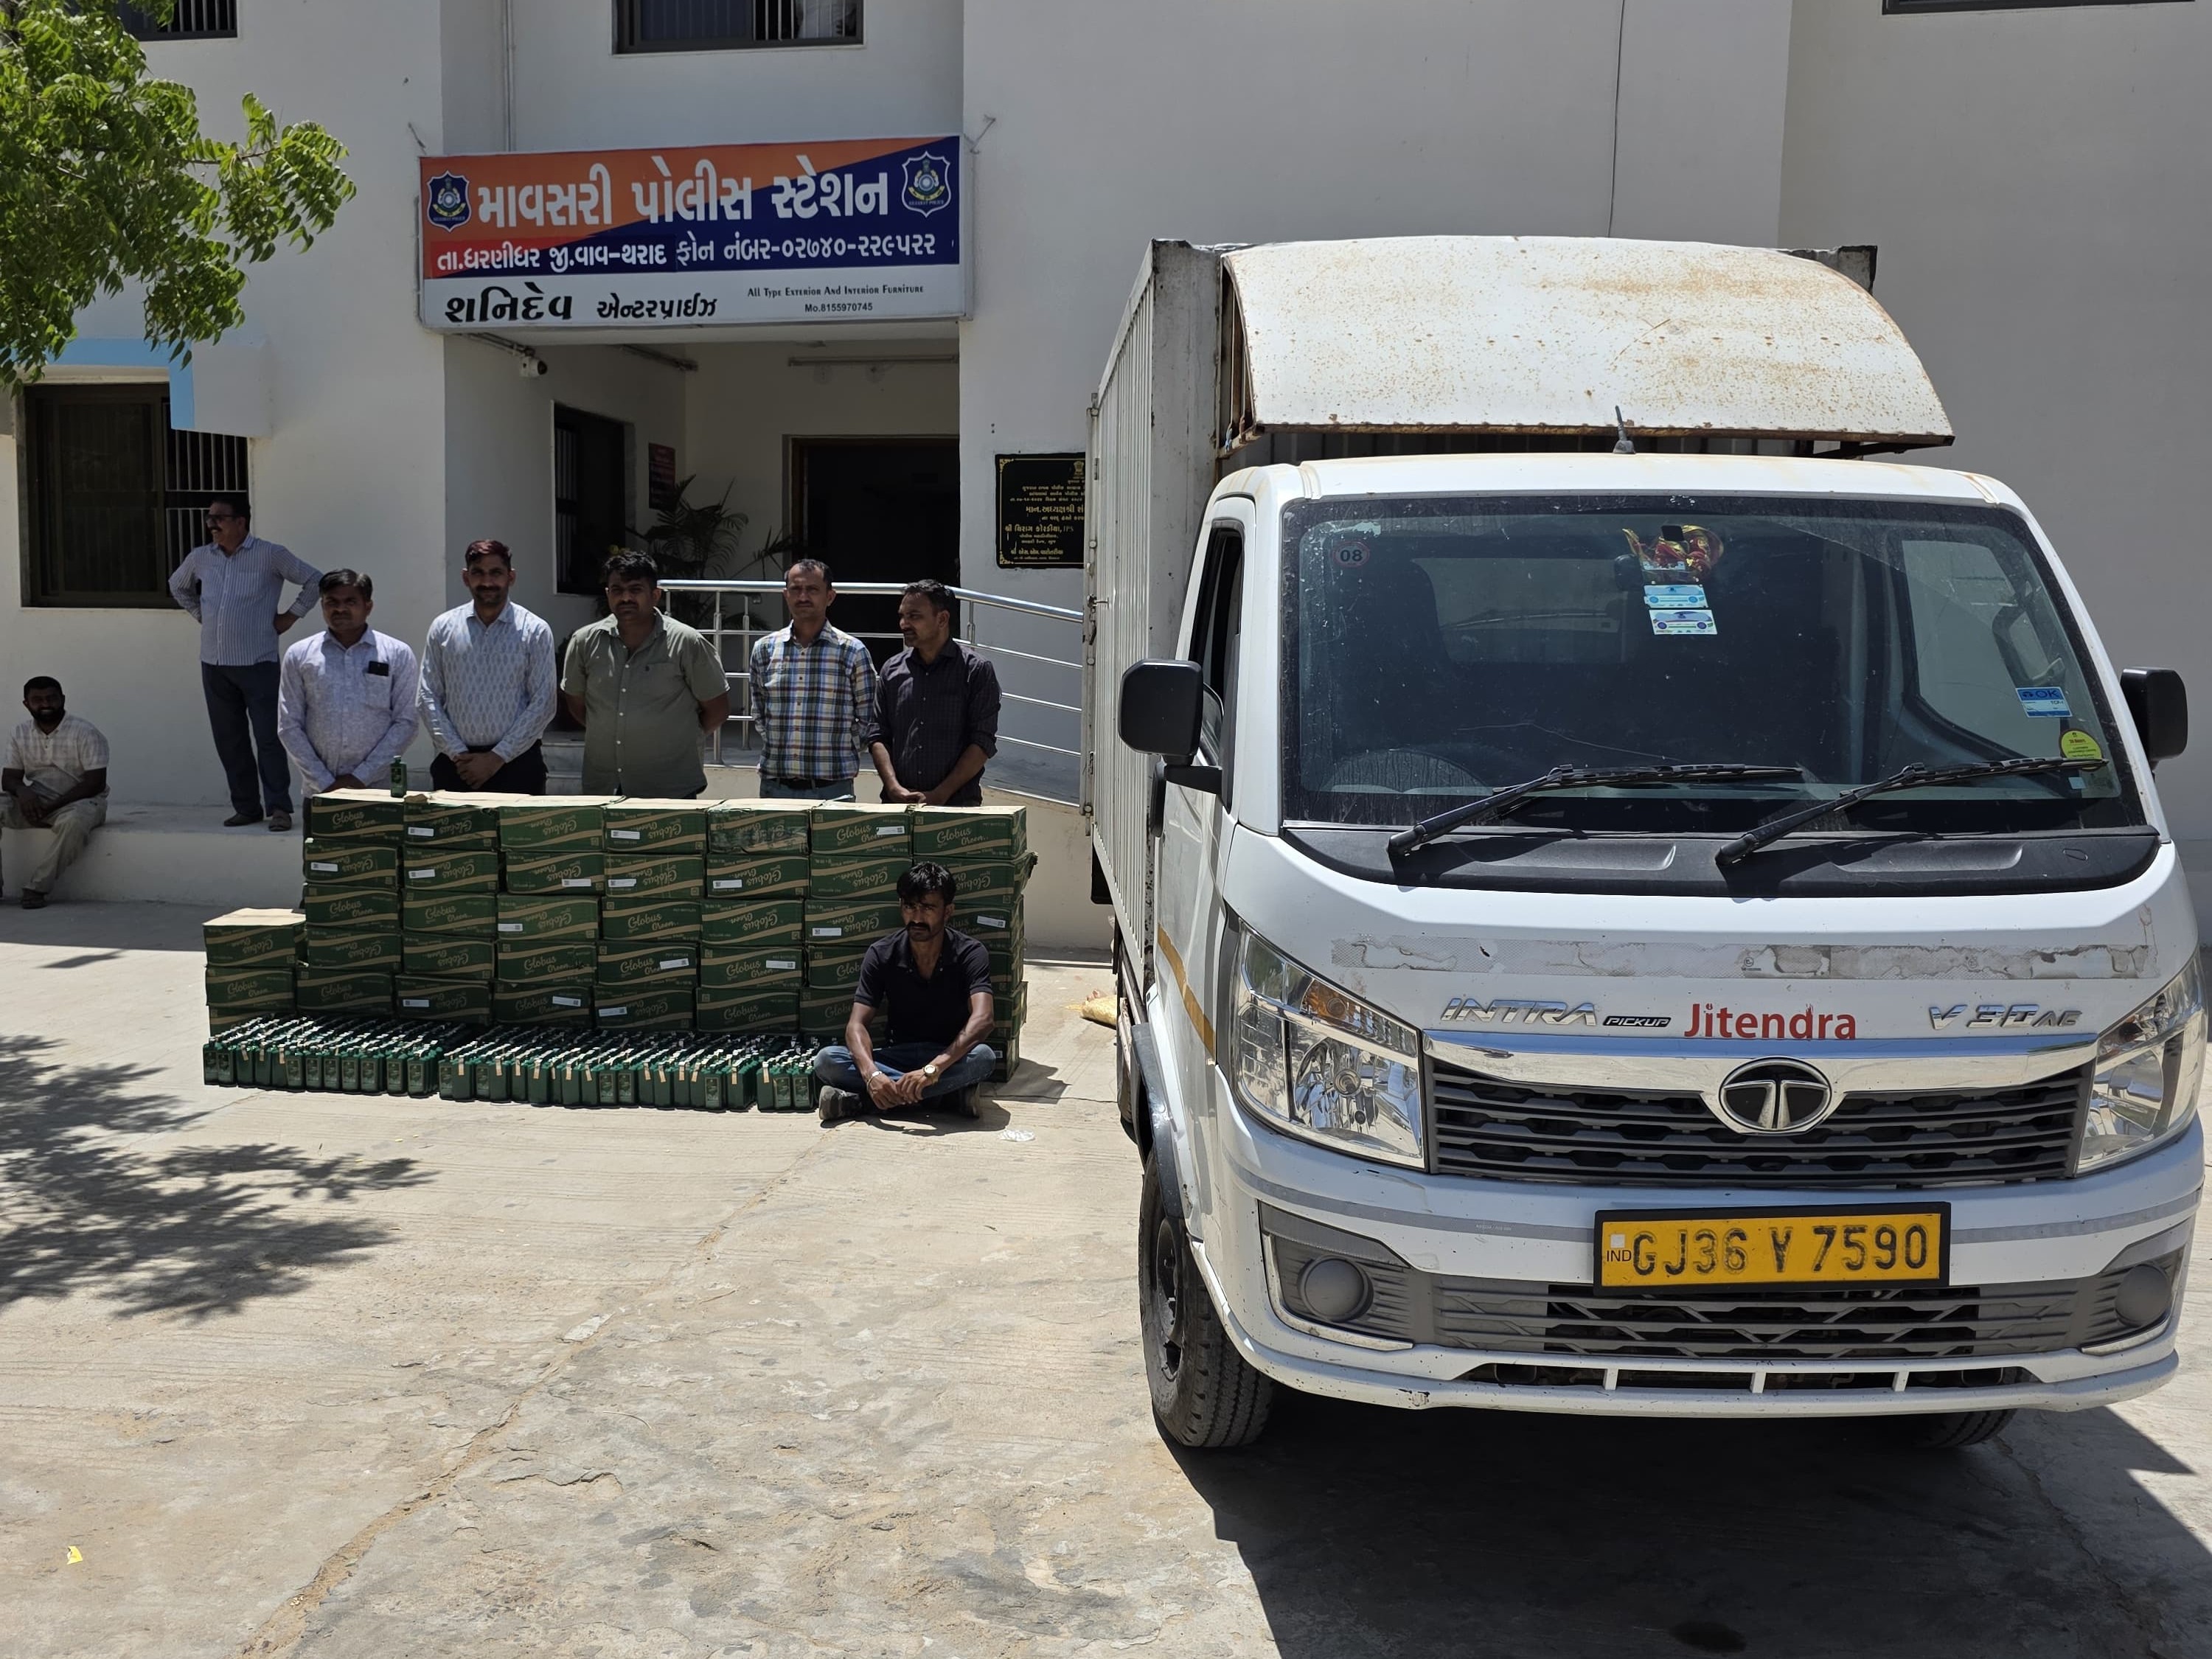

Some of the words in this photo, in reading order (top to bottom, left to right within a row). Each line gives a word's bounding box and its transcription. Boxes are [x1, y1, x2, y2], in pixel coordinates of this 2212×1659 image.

[478, 162, 613, 228] માવસરી
[631, 156, 752, 224] પોલીસ
[771, 154, 888, 219] સ્ટેશન
[437, 241, 540, 271] તા.ધરણીધર
[675, 230, 714, 266] ફોન
[445, 282, 573, 323] શનિદેવ
[804, 302, 873, 313] Mo.8155970745
[1340, 550, 1363, 562] 08
[936, 827, 973, 844] Globus
[746, 869, 782, 886] Globus
[956, 874, 991, 891] Globus
[627, 912, 663, 929] Globus
[743, 912, 778, 931] Globus
[619, 957, 654, 974] Globus
[726, 960, 761, 977] Globus
[836, 961, 861, 978] Glob
[1440, 998, 1597, 1026] INTRA
[1605, 1018, 1669, 1026] PICKUP
[1684, 1002, 1856, 1040] Jitendra
[1607, 1250, 1632, 1262] IND
[1632, 1228, 1748, 1276] GJ36
[1812, 1224, 1927, 1273] 7590
